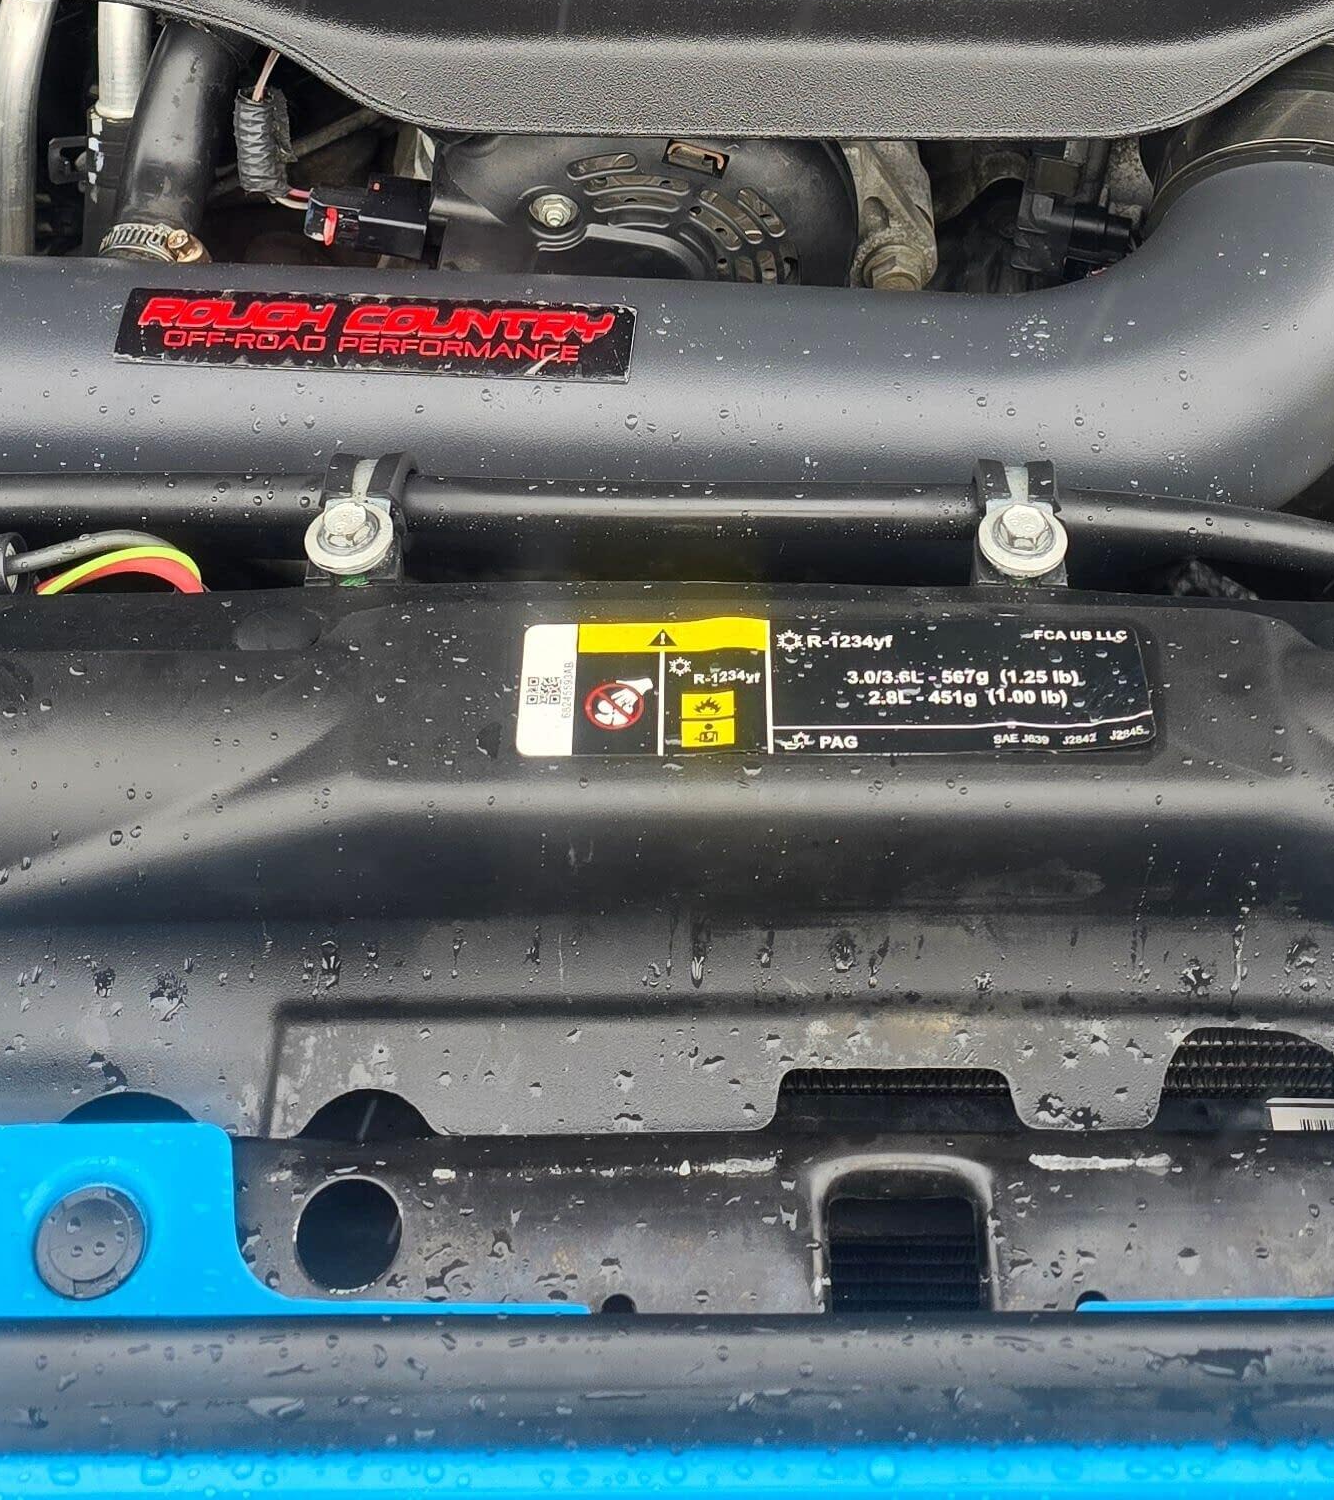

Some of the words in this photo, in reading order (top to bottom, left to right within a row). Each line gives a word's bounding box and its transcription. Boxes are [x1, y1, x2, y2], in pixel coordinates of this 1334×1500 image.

[138, 297, 338, 332] ROUGH
[343, 306, 616, 343] COUNTRY
[163, 329, 326, 352] OFF-ROAD
[338, 338, 580, 362] PERFORMANCE
[807, 634, 892, 650] R-1234yf
[1033, 630, 1067, 641] FCA
[1070, 630, 1092, 641] US
[1096, 630, 1128, 642] LLC
[693, 669, 761, 686] R-1234yf
[846, 670, 924, 684] 3.0/3.6L
[941, 670, 989, 686] 567g
[1000, 668, 1048, 687] (1.25
[1052, 669, 1079, 687] lb)
[868, 689, 912, 704] 2.8L
[927, 689, 977, 707] 451g
[988, 687, 1034, 706] (1.00
[1041, 687, 1068, 708] lb)
[819, 735, 859, 750] PAG
[993, 733, 1019, 745] SAE
